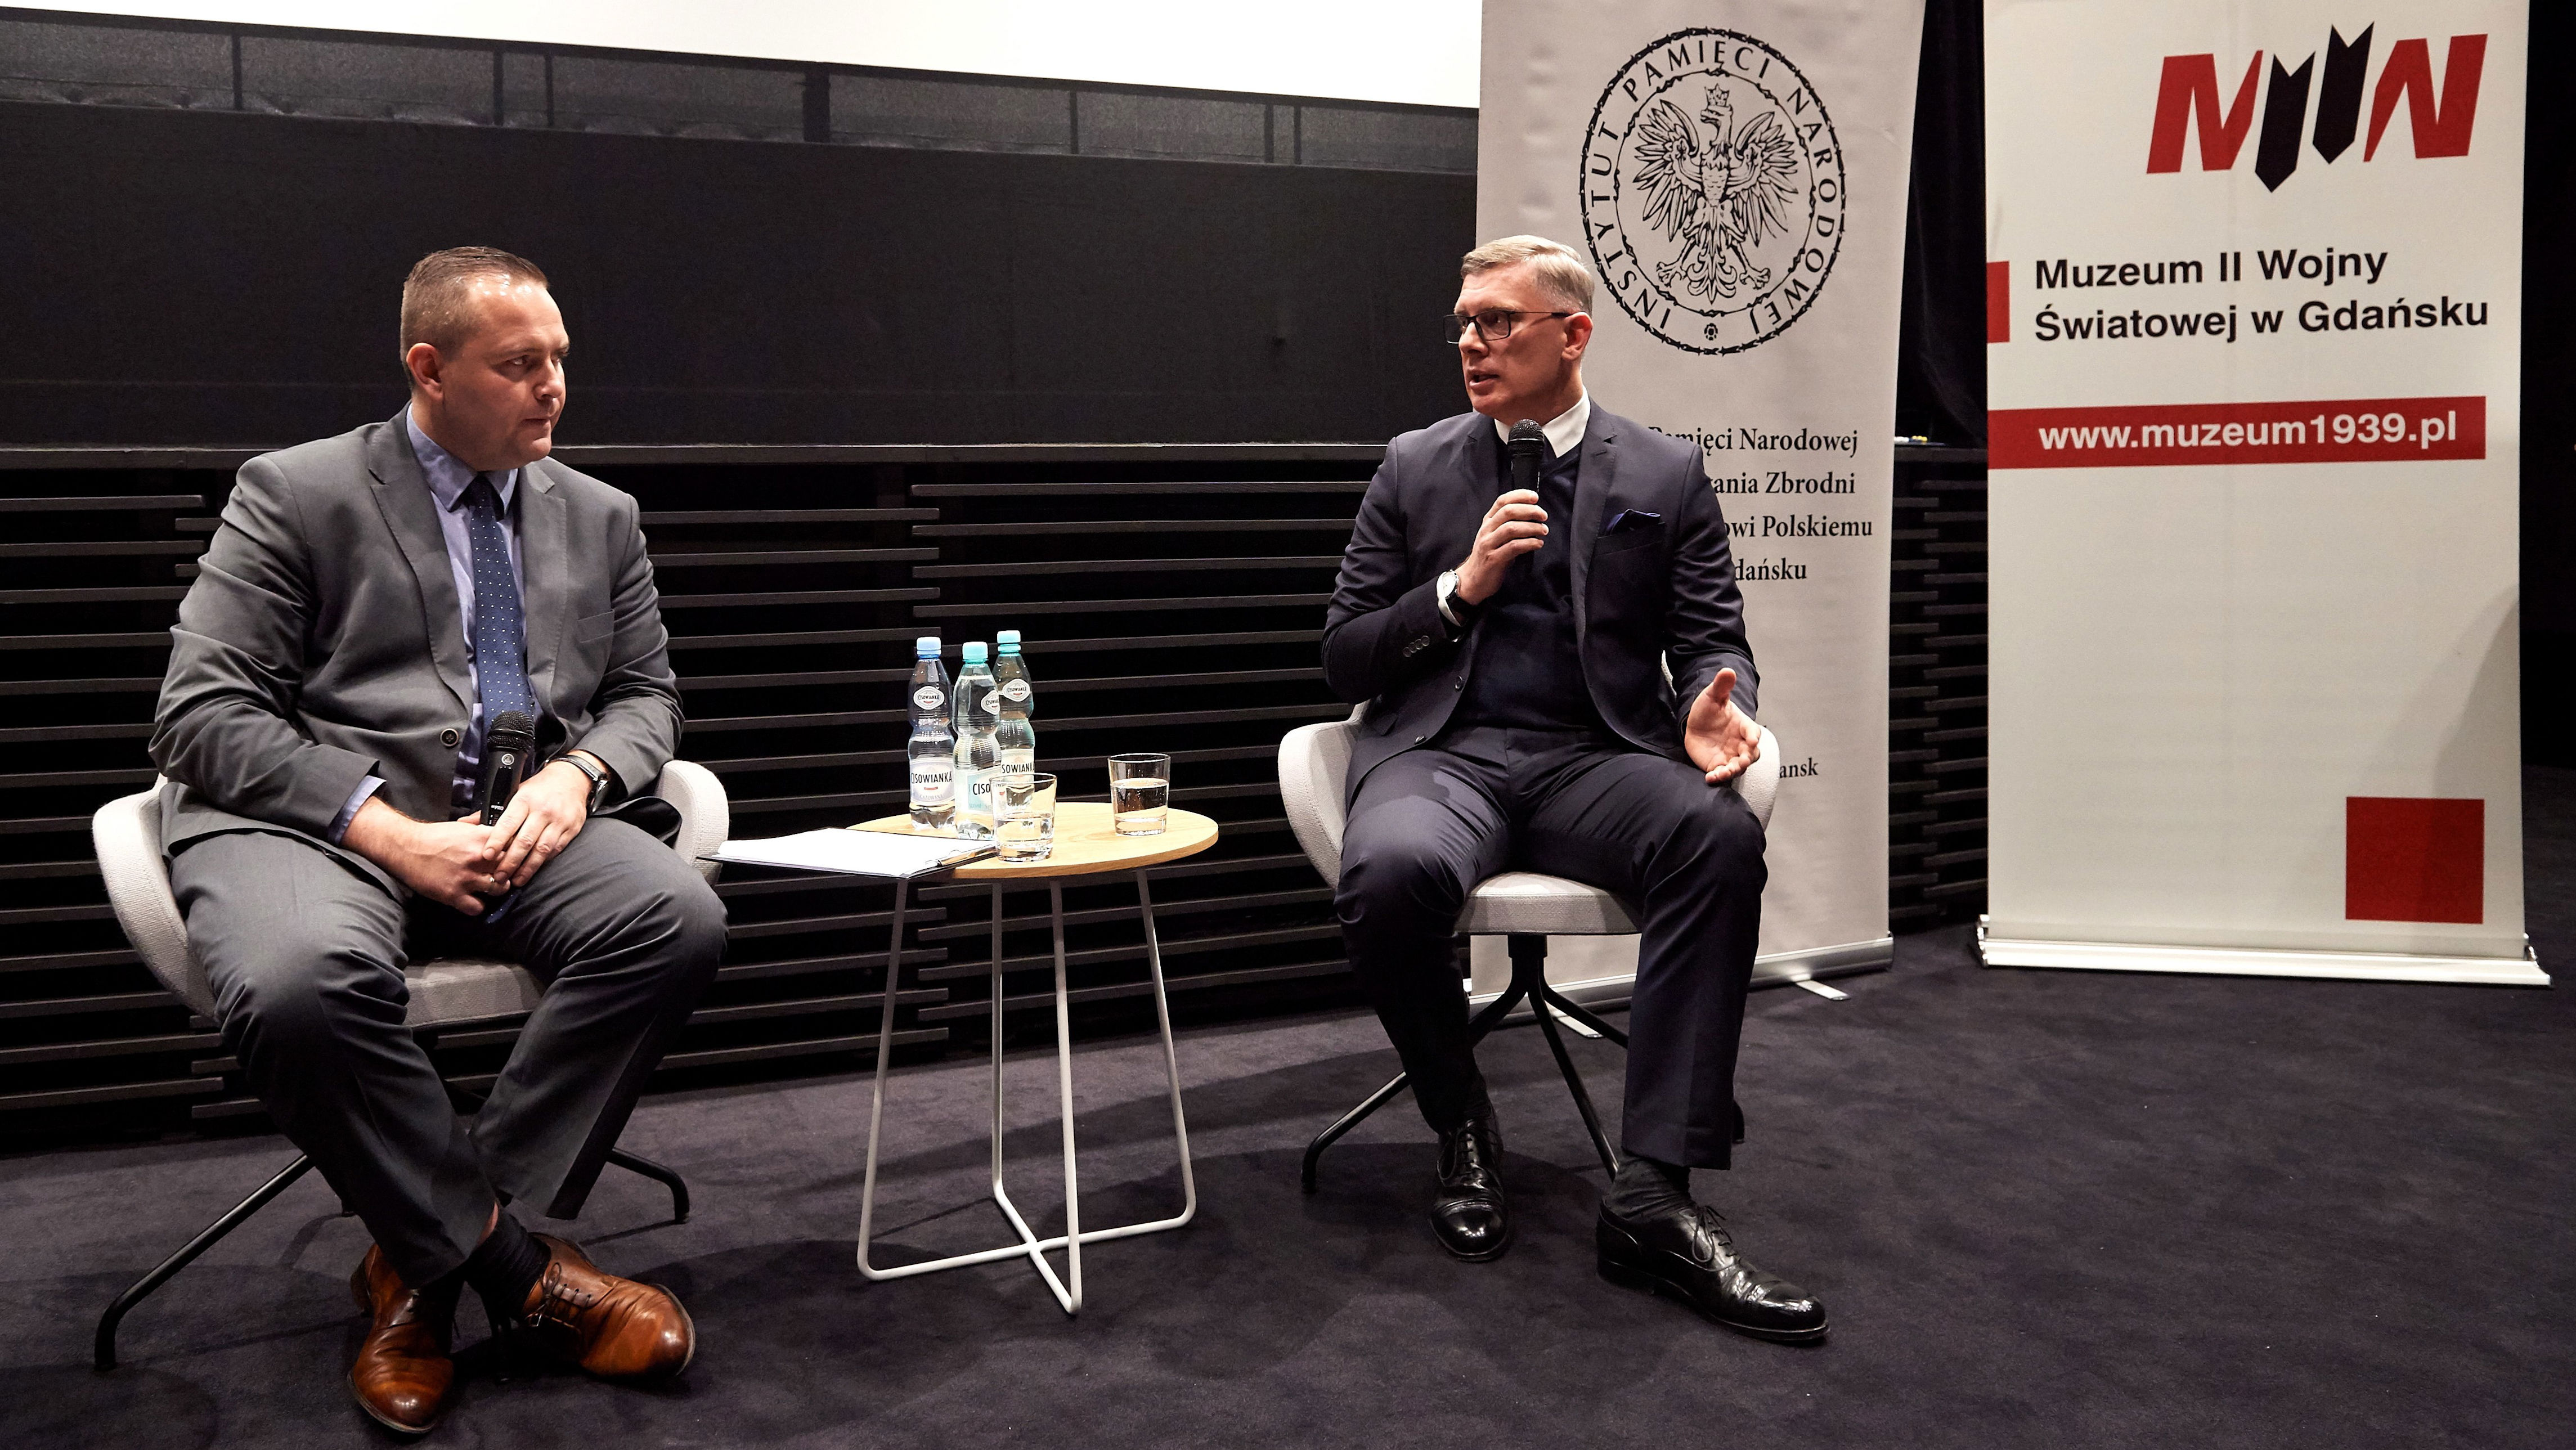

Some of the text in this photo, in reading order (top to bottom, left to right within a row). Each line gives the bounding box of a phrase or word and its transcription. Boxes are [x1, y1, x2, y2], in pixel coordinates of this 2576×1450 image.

[1591, 40, 1837, 334] INSTYTUT PAMIĘCI NARODOWEJ
[2036, 248, 2388, 290] Muzeum II Wojny
[2035, 296, 2488, 343] Światowej w Gdańsku
[1739, 428, 1858, 458] Narodowej
[2039, 411, 2457, 451] www.muzeum1939.pl
[1713, 471, 1856, 495] ania Zbrodni
[1762, 514, 1873, 537] Polskiemu
[1735, 558, 1807, 581] dańsku
[911, 771, 952, 784] CISOWIANKA
[1780, 757, 1819, 779] ansk
[972, 783, 990, 795] CISO
